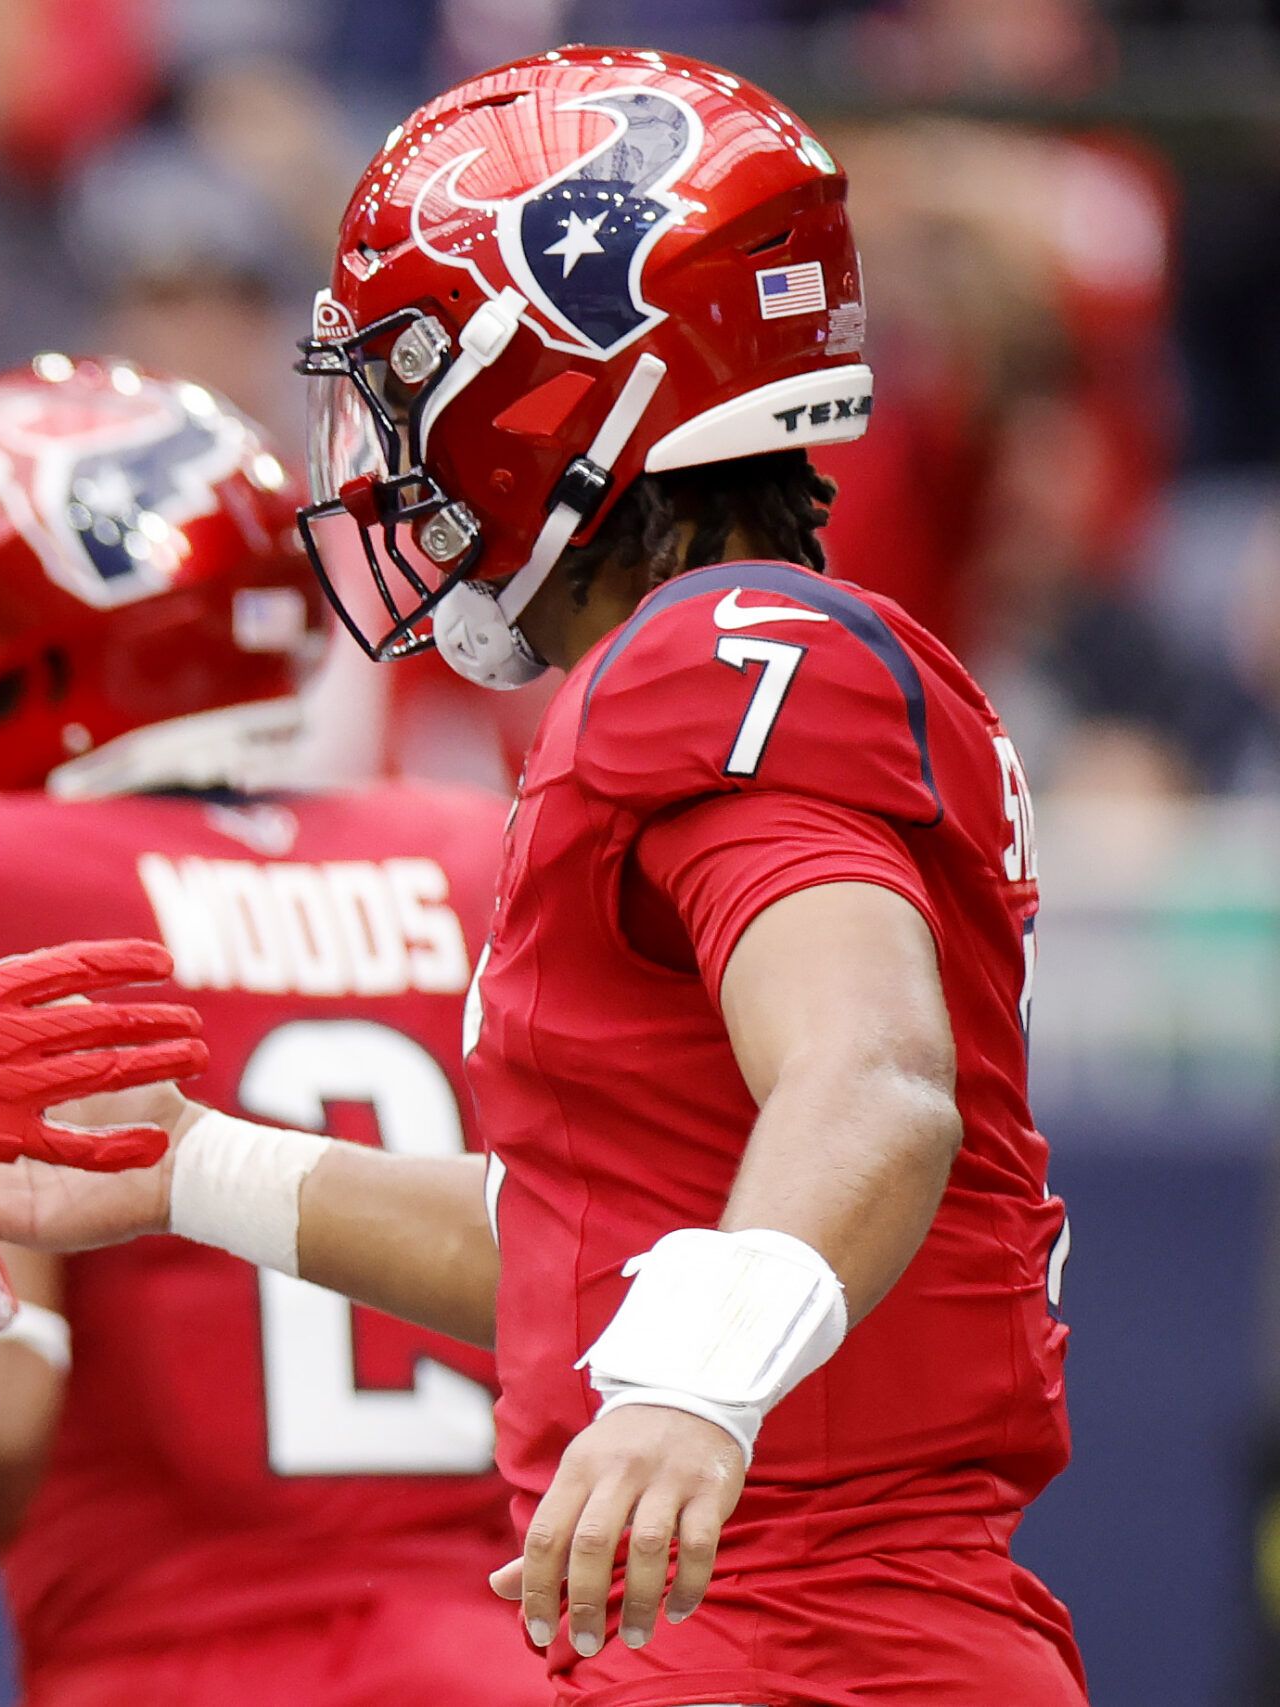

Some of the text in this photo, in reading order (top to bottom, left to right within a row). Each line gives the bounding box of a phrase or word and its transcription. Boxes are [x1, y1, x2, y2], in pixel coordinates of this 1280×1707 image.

[714, 634, 808, 780] 7
[137, 852, 470, 995] WOODS
[236, 1016, 498, 1480] 2
